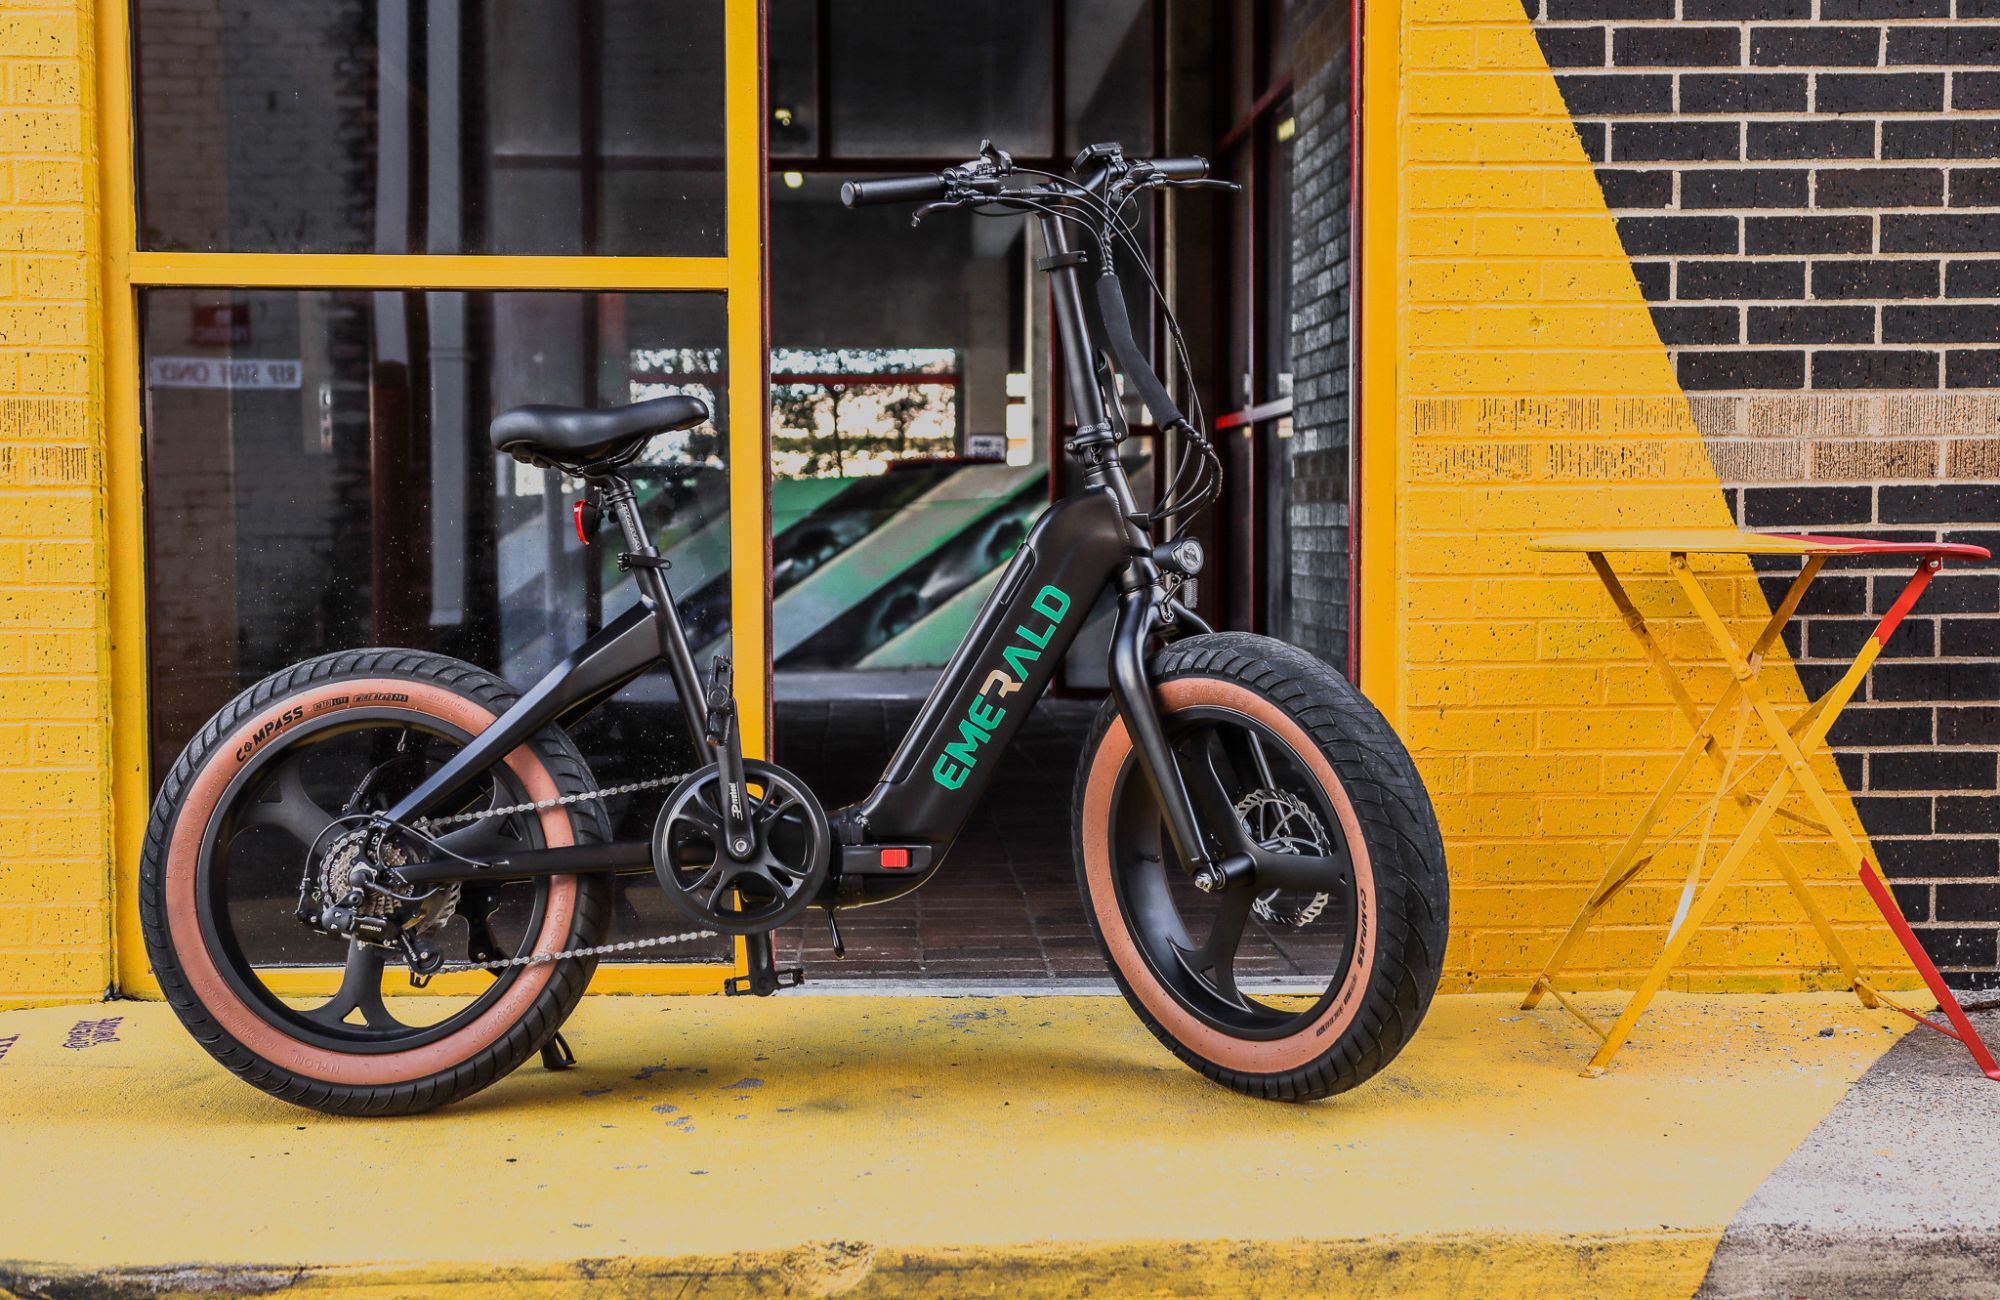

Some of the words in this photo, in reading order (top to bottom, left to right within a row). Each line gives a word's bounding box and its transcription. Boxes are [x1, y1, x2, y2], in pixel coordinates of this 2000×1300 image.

[932, 584, 1072, 791] EMERALD
[236, 705, 304, 763] COMPASS
[1357, 888, 1368, 968] COMPASS
